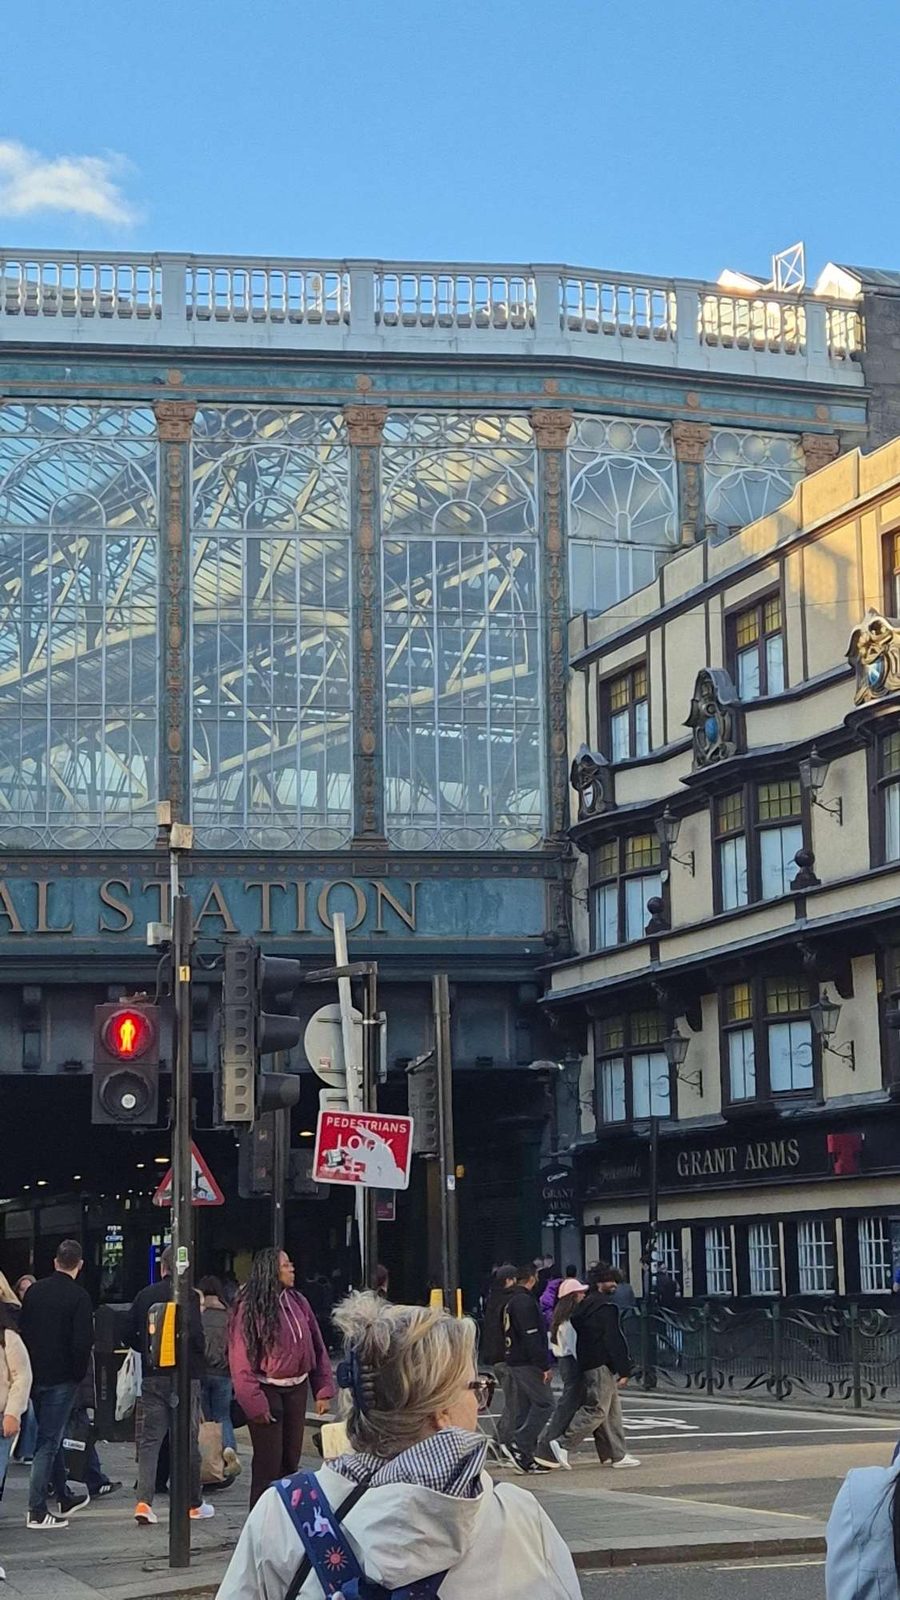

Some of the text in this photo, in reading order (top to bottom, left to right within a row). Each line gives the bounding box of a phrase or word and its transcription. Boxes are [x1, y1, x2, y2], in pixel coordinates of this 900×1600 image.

[98, 879, 421, 934] STATION
[326, 1116, 408, 1134] PEDESTRIANS
[677, 1145, 738, 1177] GRANT
[745, 1138, 801, 1171] ARMS
